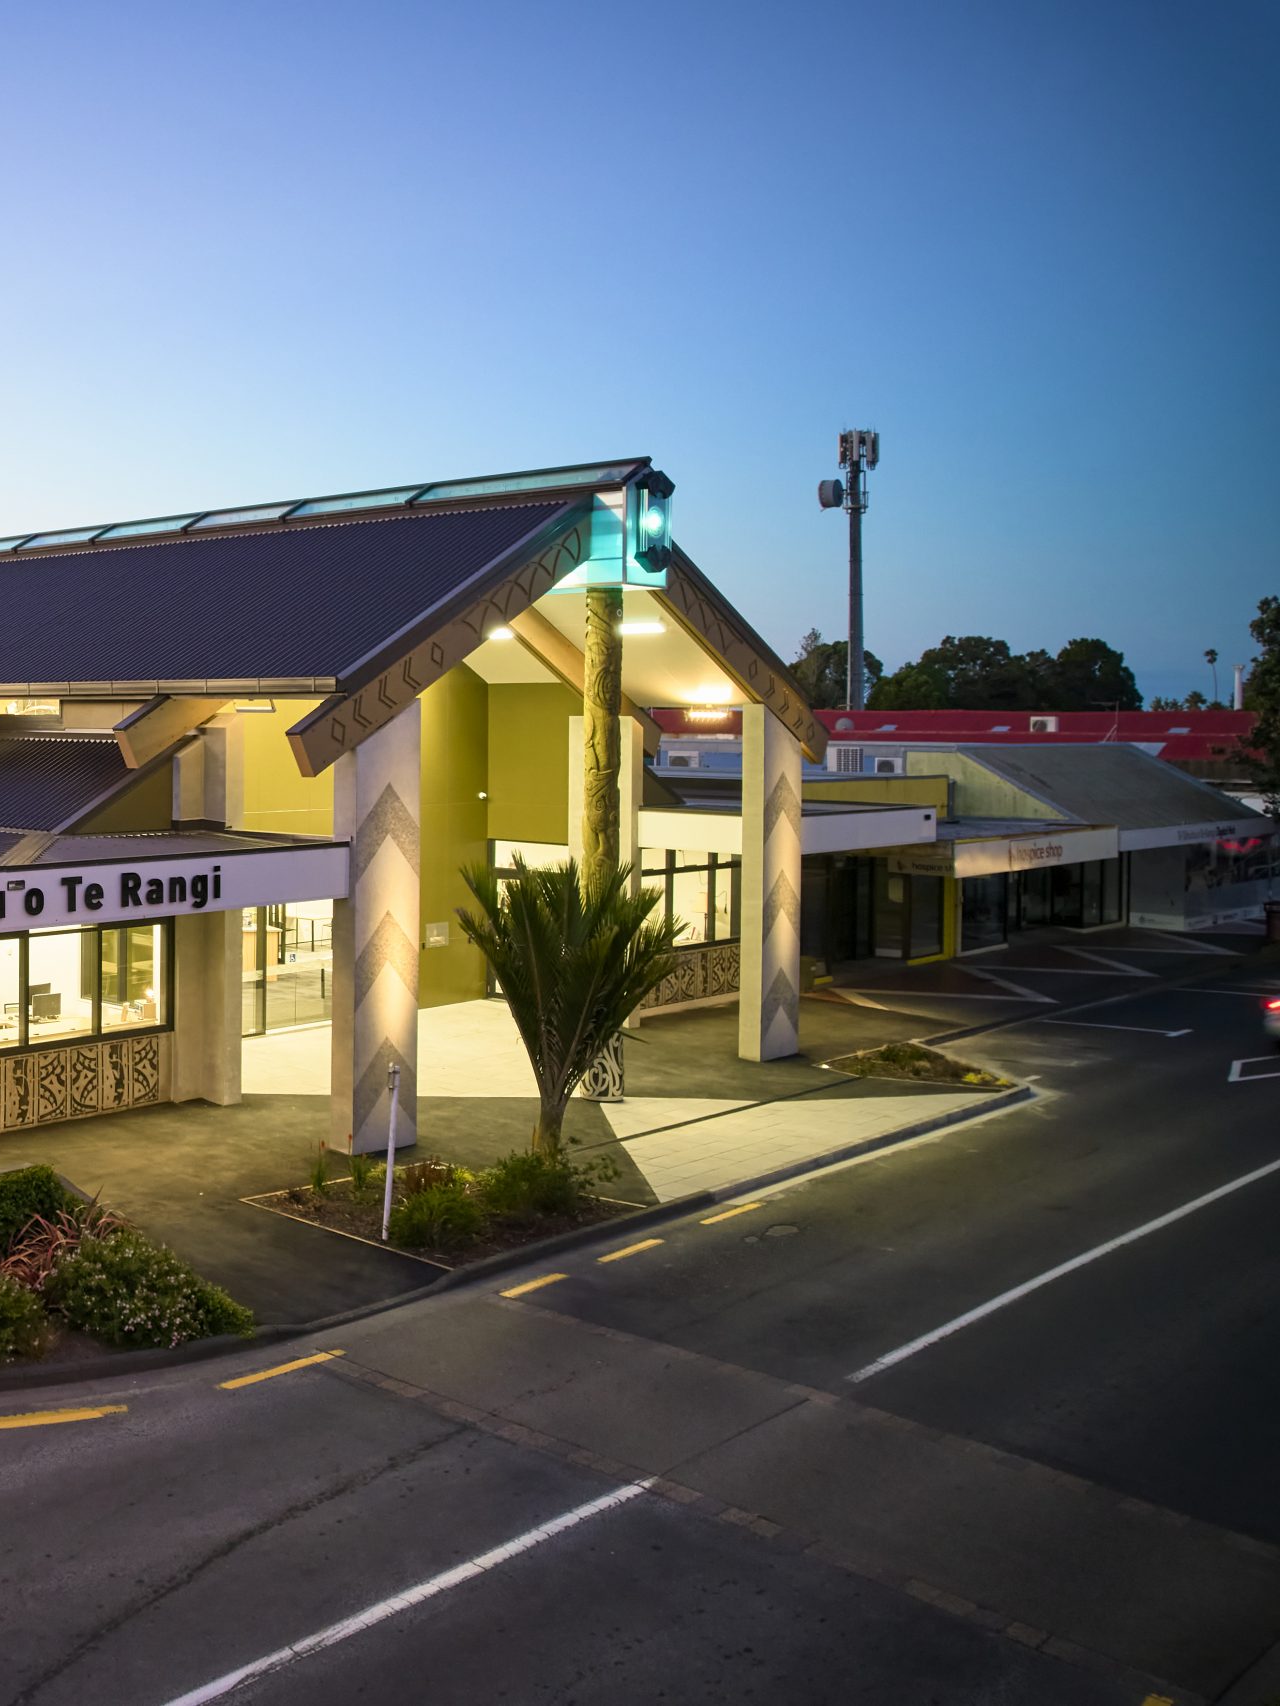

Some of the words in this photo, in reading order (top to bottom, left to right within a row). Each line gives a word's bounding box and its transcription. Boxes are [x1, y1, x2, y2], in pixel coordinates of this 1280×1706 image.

[1045, 841, 1063, 861] shop
[912, 862, 943, 873] hospice
[24, 887, 45, 916] o
[61, 875, 105, 913] Te
[120, 865, 221, 909] Rangi
